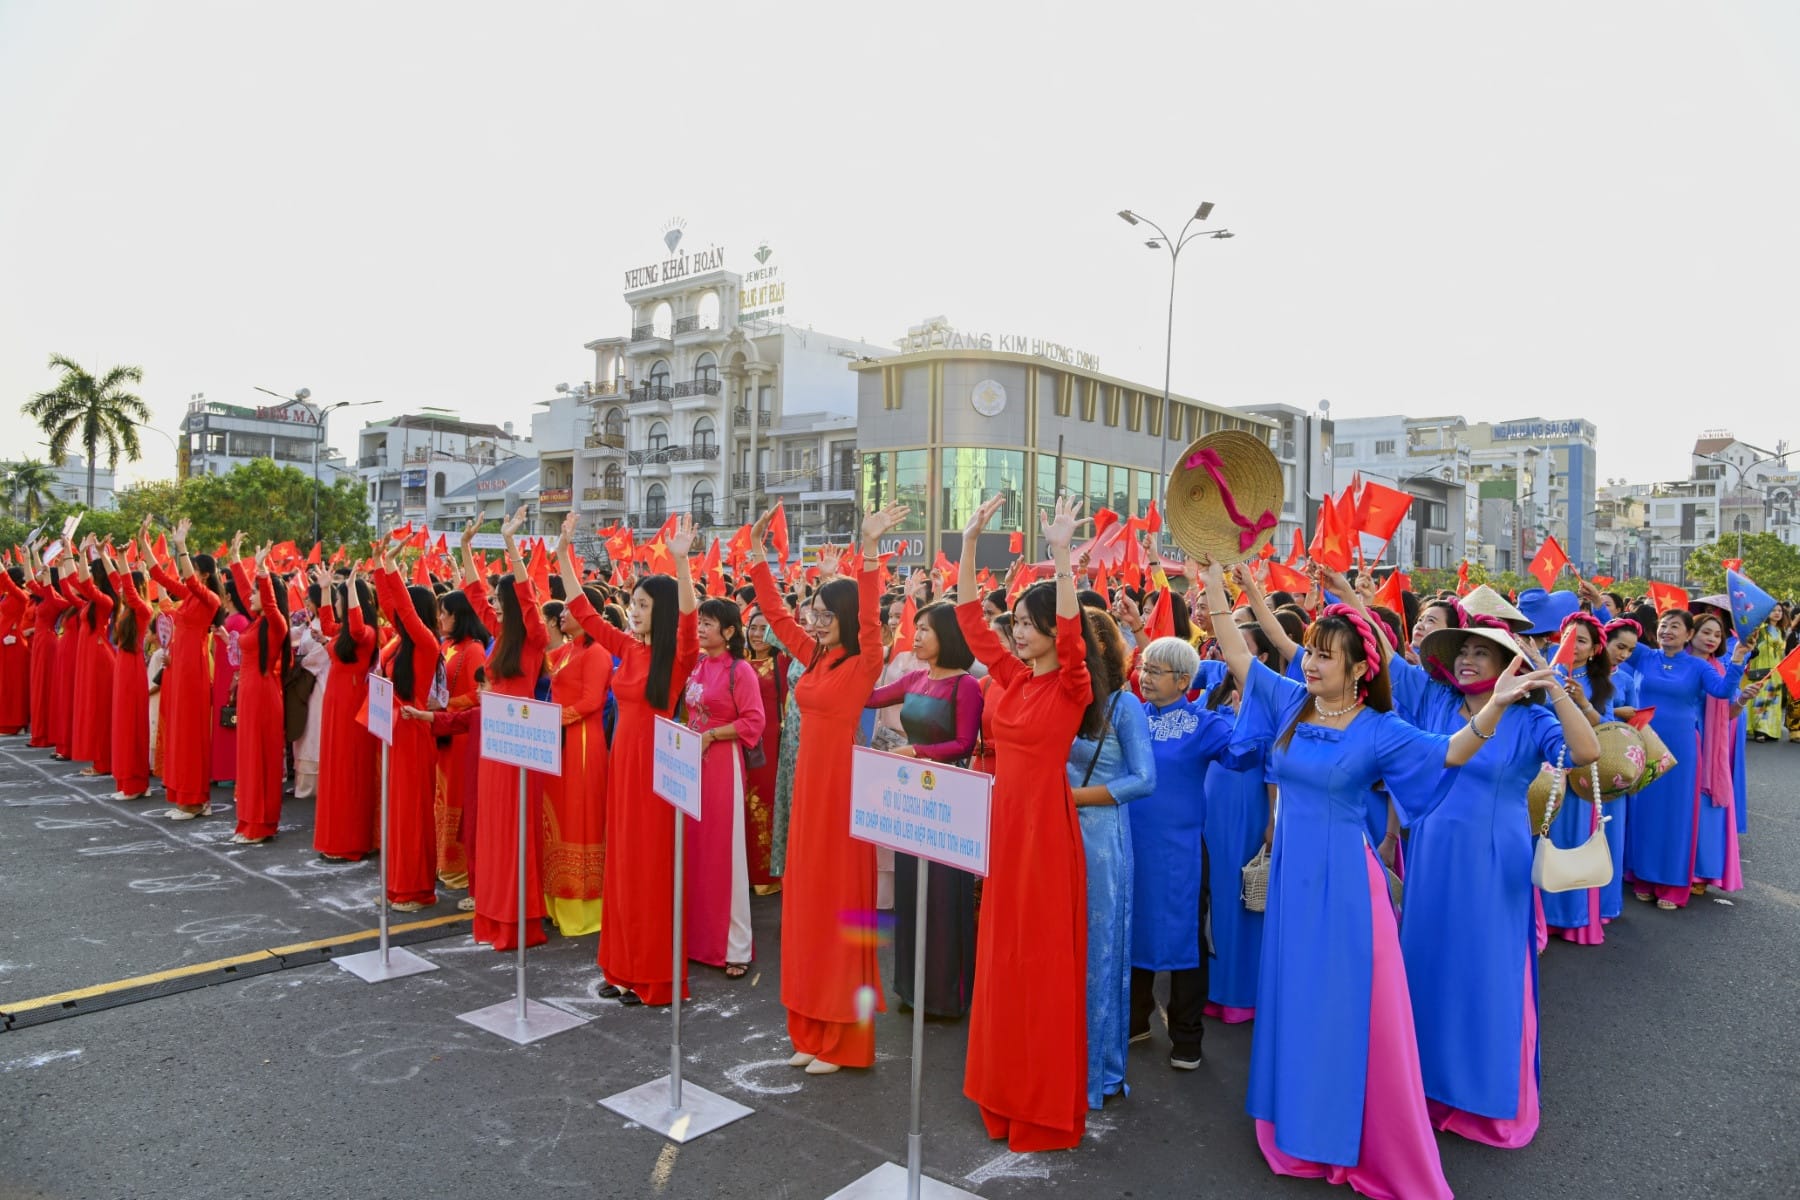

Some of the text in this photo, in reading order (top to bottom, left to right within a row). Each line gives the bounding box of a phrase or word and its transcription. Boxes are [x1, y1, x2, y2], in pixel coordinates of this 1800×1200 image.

[624, 263, 659, 290] NHUNG
[745, 266, 778, 283] JEWELRY
[1000, 334, 1028, 353] KIM
[256, 405, 289, 421] KIM
[877, 539, 923, 556] MOND
